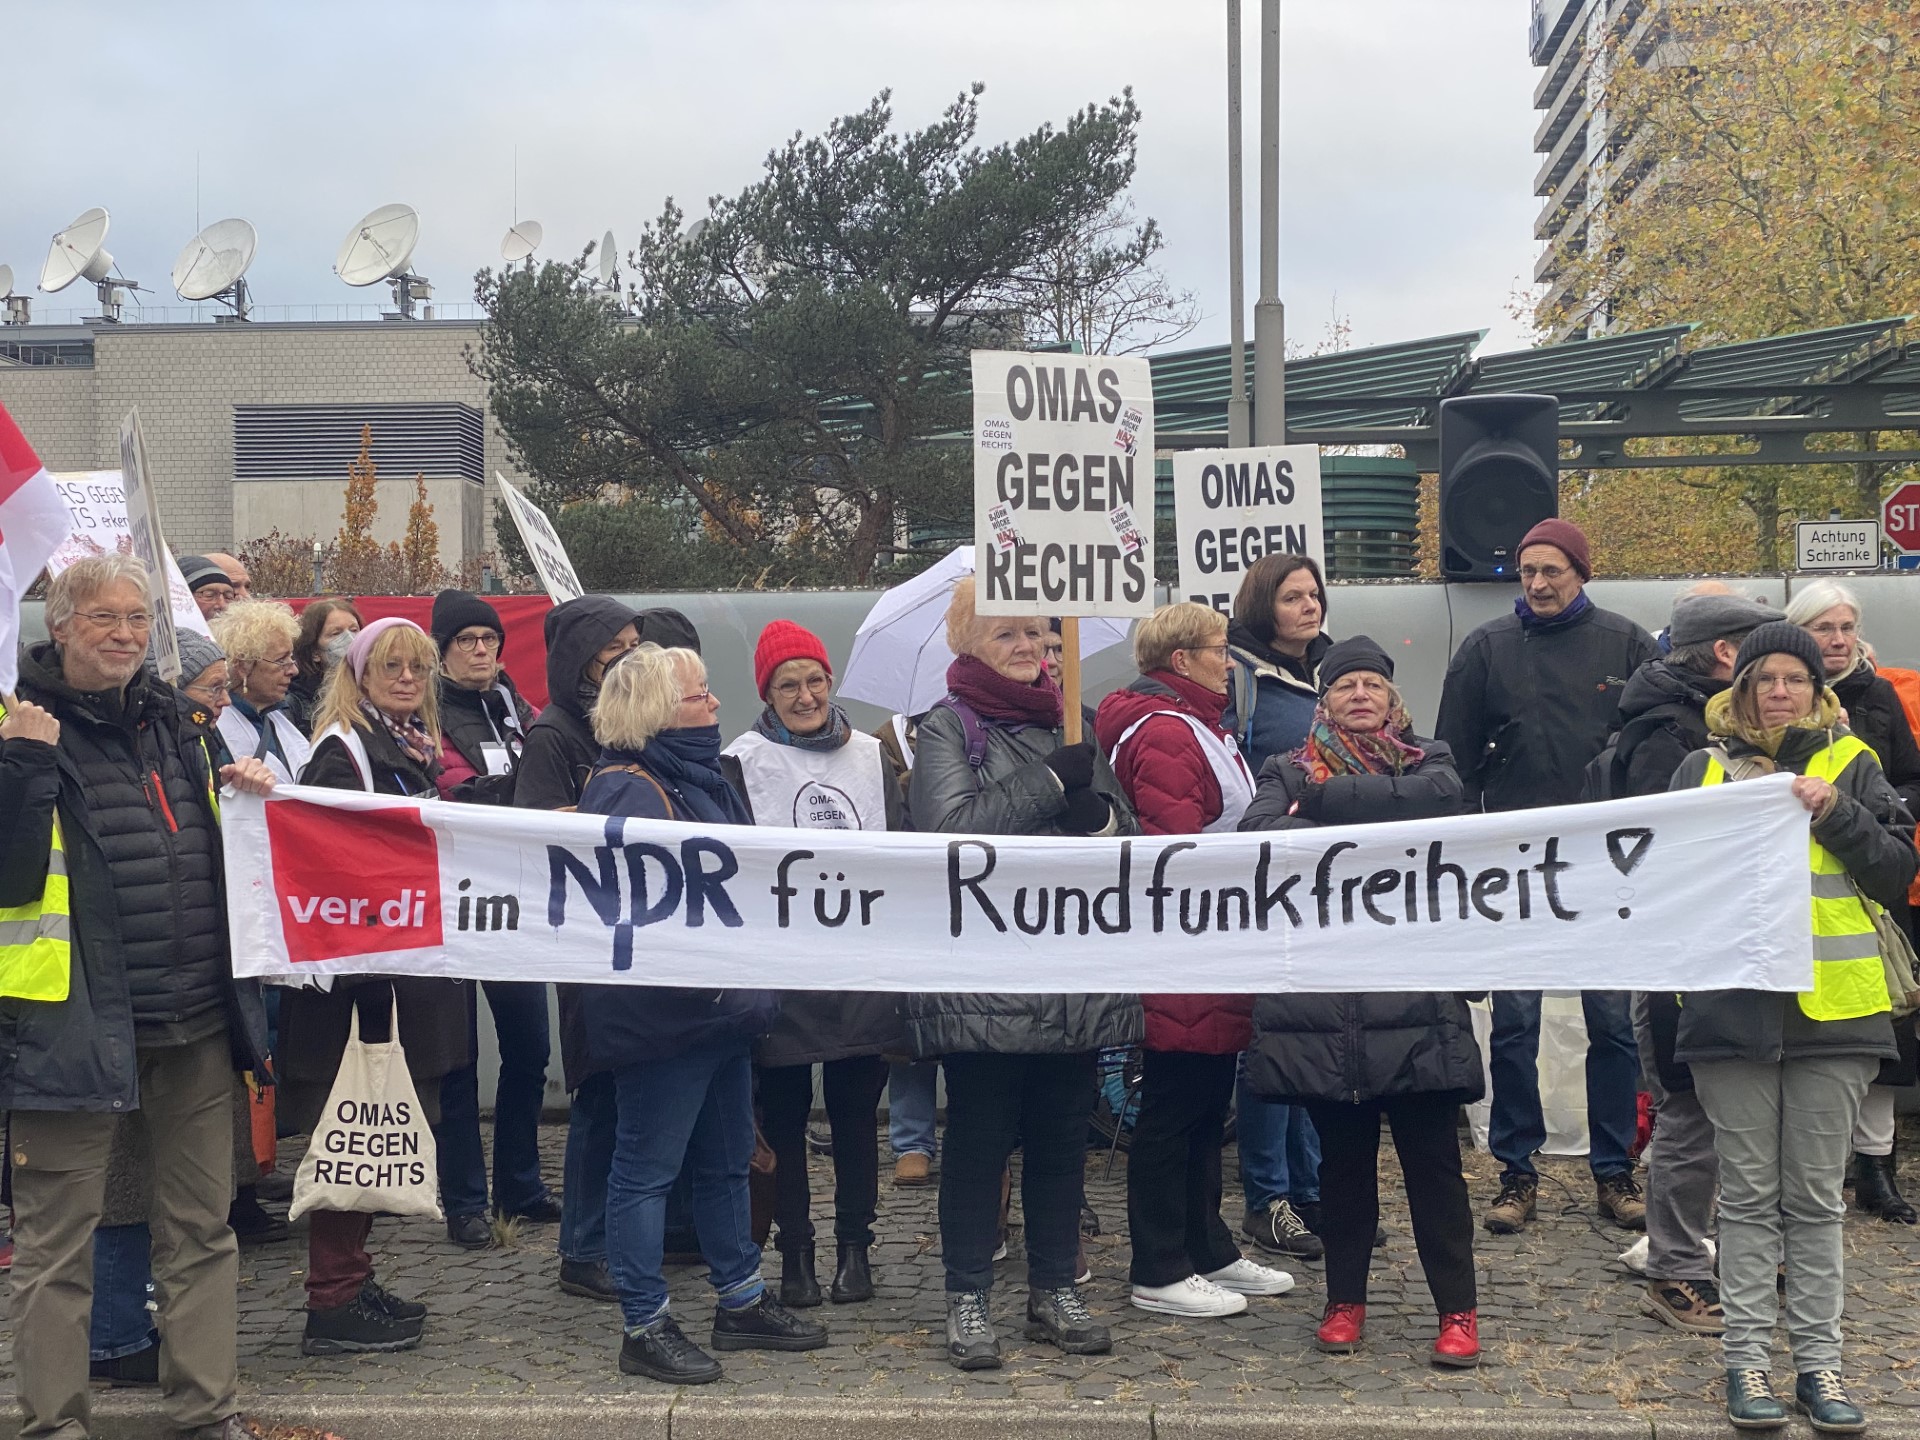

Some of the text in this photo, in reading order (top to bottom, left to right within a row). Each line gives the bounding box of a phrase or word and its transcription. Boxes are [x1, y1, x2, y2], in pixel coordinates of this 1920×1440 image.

[1006, 364, 1122, 424] OMAS
[982, 430, 1012, 440] GEGEN
[984, 419, 1010, 429] OMAS
[981, 441, 1013, 450] RECHTS
[996, 452, 1134, 512] GEGEN
[1201, 459, 1295, 509] OMAS
[1889, 504, 1920, 532] ST
[1195, 523, 1308, 574] GEGEN
[1811, 530, 1866, 545] Achtung
[1806, 548, 1870, 562] Schranke
[986, 543, 1146, 604] RECHTS
[809, 795, 837, 806] OMA
[809, 810, 846, 821] GEGEN
[287, 888, 426, 928] ver.di
[457, 878, 519, 931] im
[546, 816, 744, 970] NDR
[771, 850, 884, 928] für
[337, 1100, 410, 1126] OMAS
[325, 1129, 418, 1157] GEGEN
[314, 1159, 425, 1188] RECHTS
